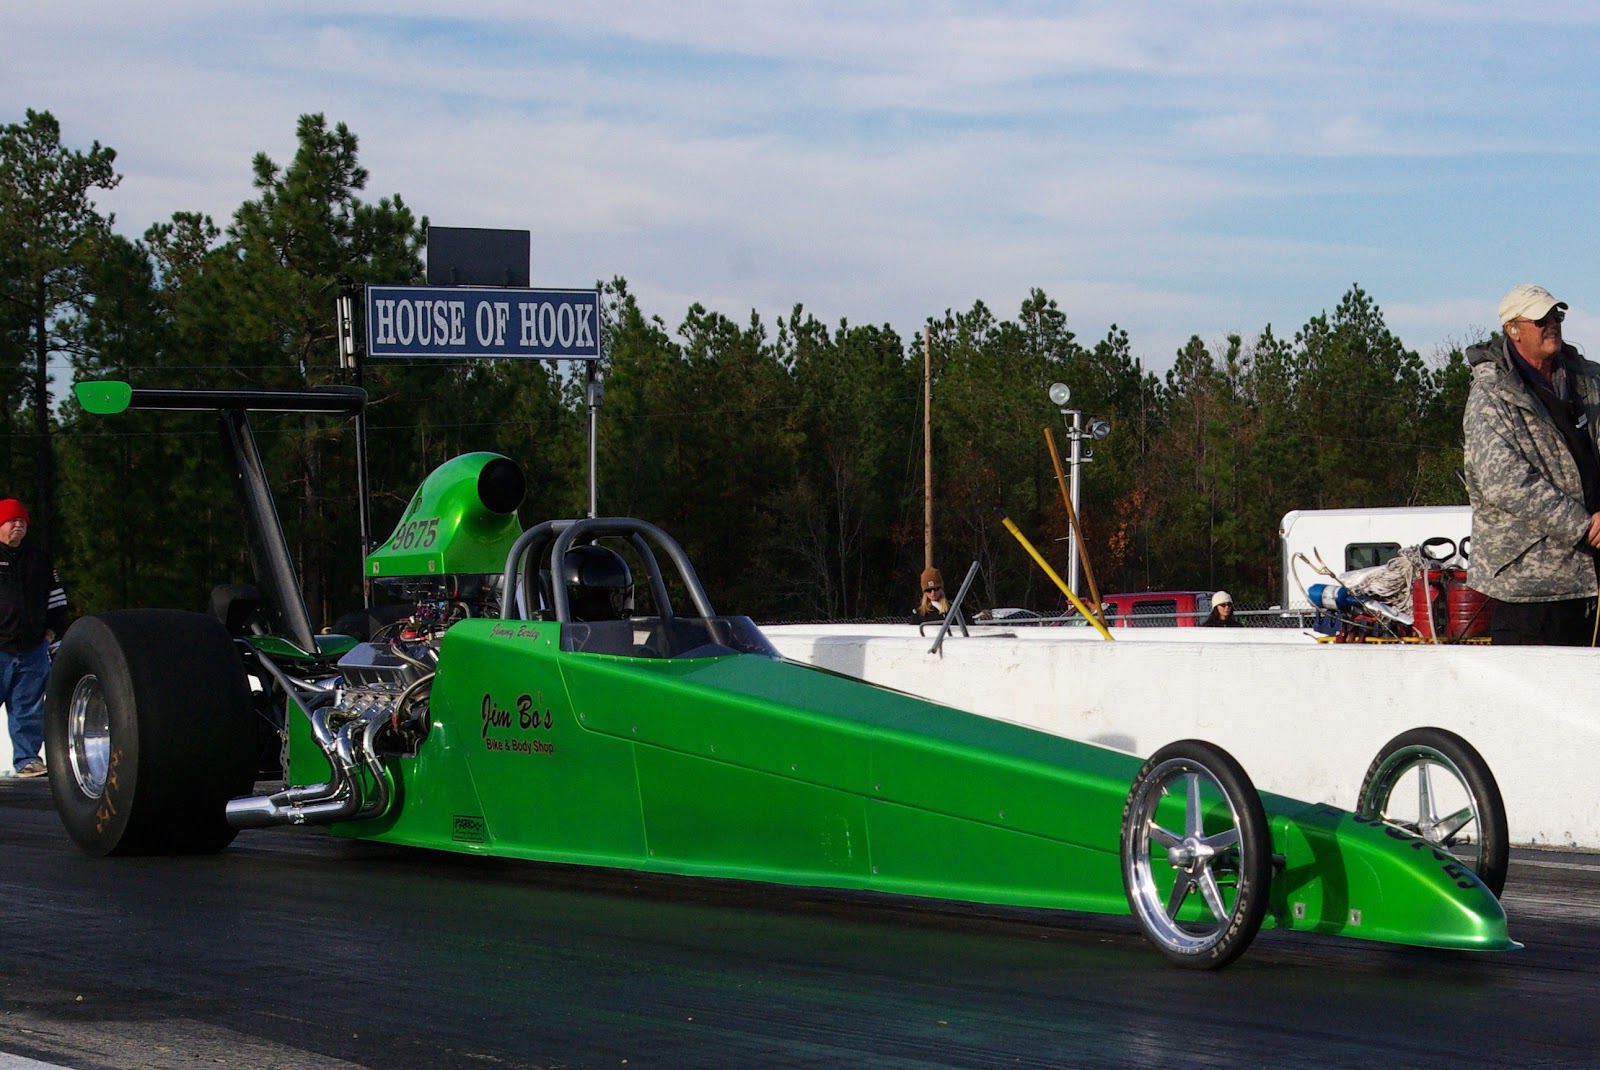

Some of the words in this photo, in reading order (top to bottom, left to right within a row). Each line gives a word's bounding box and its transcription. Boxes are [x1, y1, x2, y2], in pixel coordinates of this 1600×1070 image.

[375, 299, 466, 346] HOUSE
[475, 300, 509, 347] OF
[519, 302, 595, 348] HOOK
[391, 517, 440, 550] 9675
[482, 693, 511, 738] Jim
[516, 691, 553, 729] Bo's
[486, 738, 503, 751] Bike
[504, 739, 511, 751] &
[512, 740, 532, 755] Body
[533, 740, 554, 755] Shop
